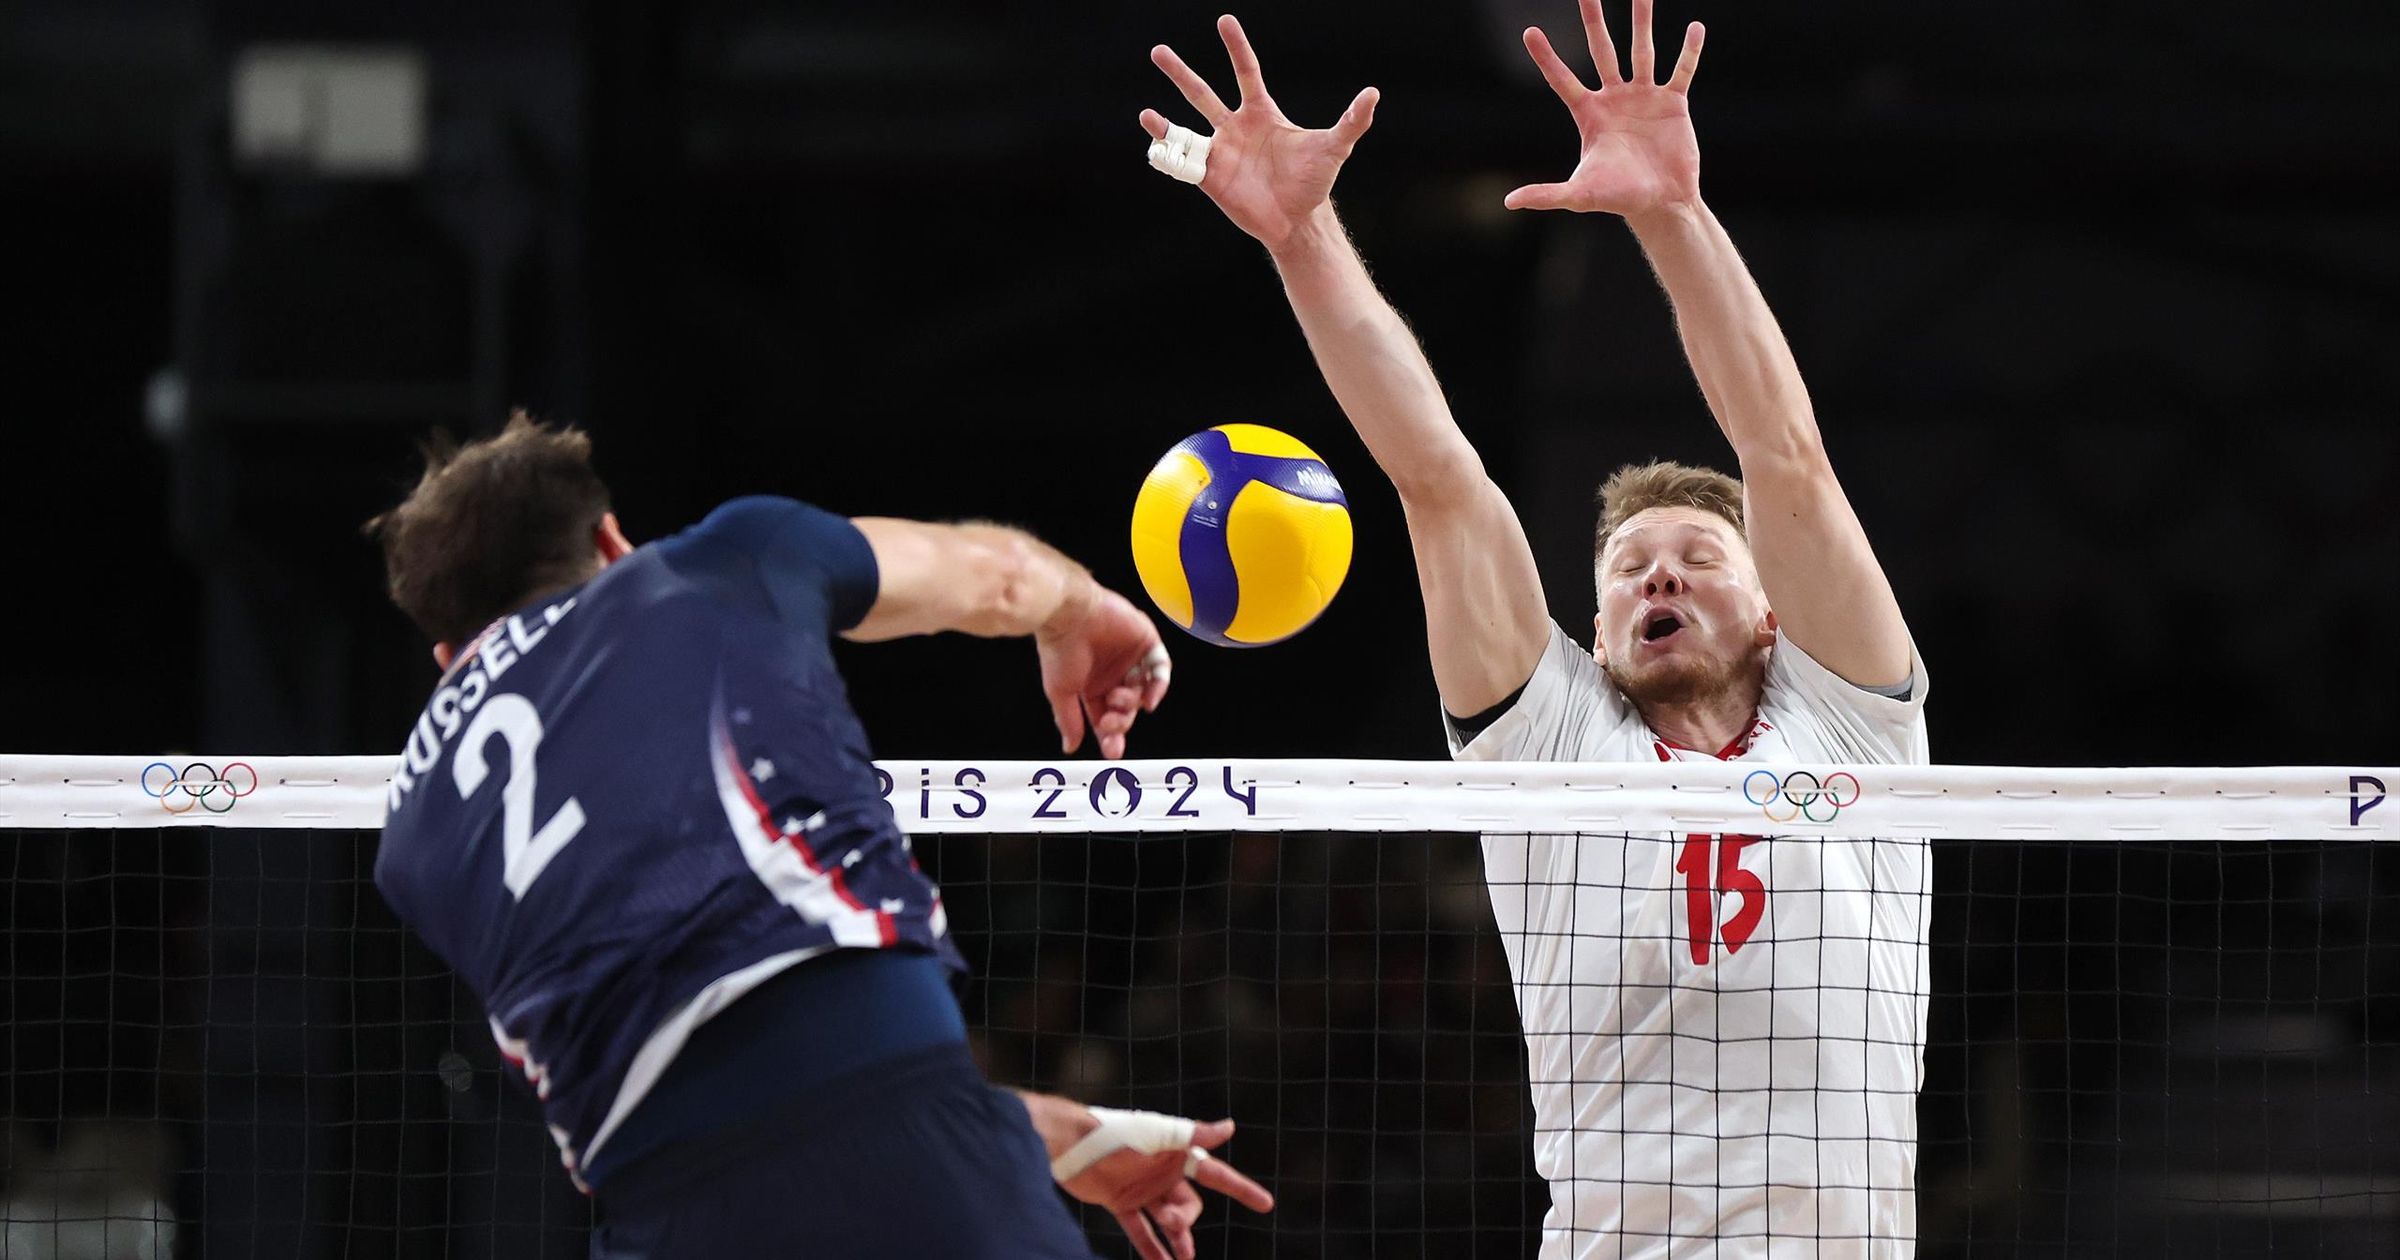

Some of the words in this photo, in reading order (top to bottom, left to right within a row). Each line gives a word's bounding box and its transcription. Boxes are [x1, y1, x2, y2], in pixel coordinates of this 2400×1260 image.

[452, 693, 587, 902] 2
[1031, 766, 1257, 819] 2024
[1676, 832, 1766, 966] 15
